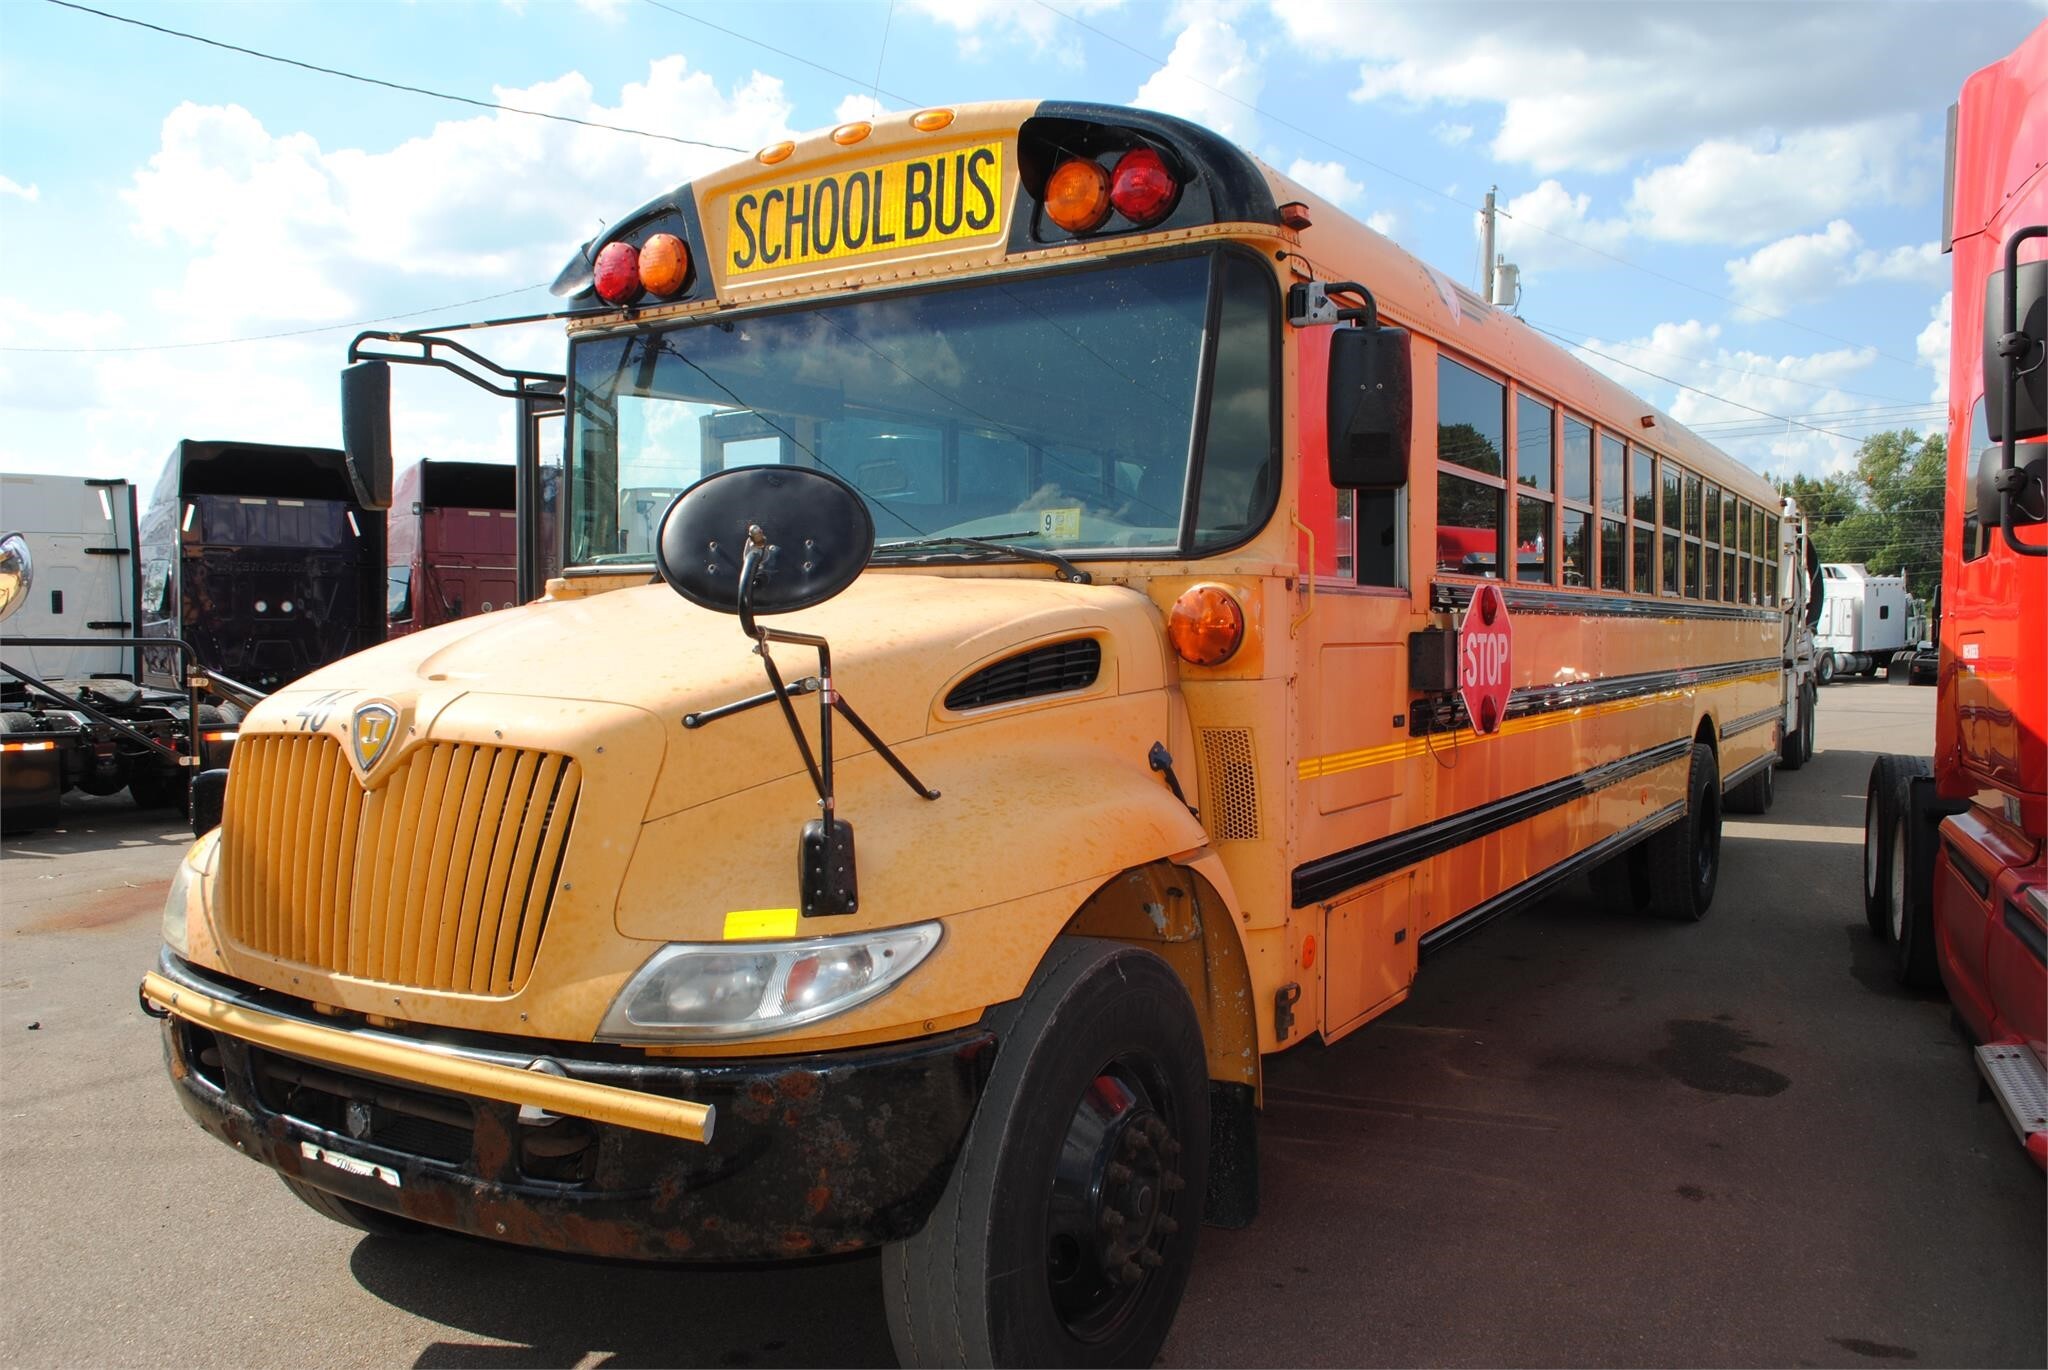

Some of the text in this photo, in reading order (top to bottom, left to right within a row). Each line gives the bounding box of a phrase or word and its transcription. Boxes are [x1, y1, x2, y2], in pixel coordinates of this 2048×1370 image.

[733, 148, 996, 269] SCHOOL BUS
[1045, 514, 1052, 531] 9
[1466, 632, 1508, 688] STOP
